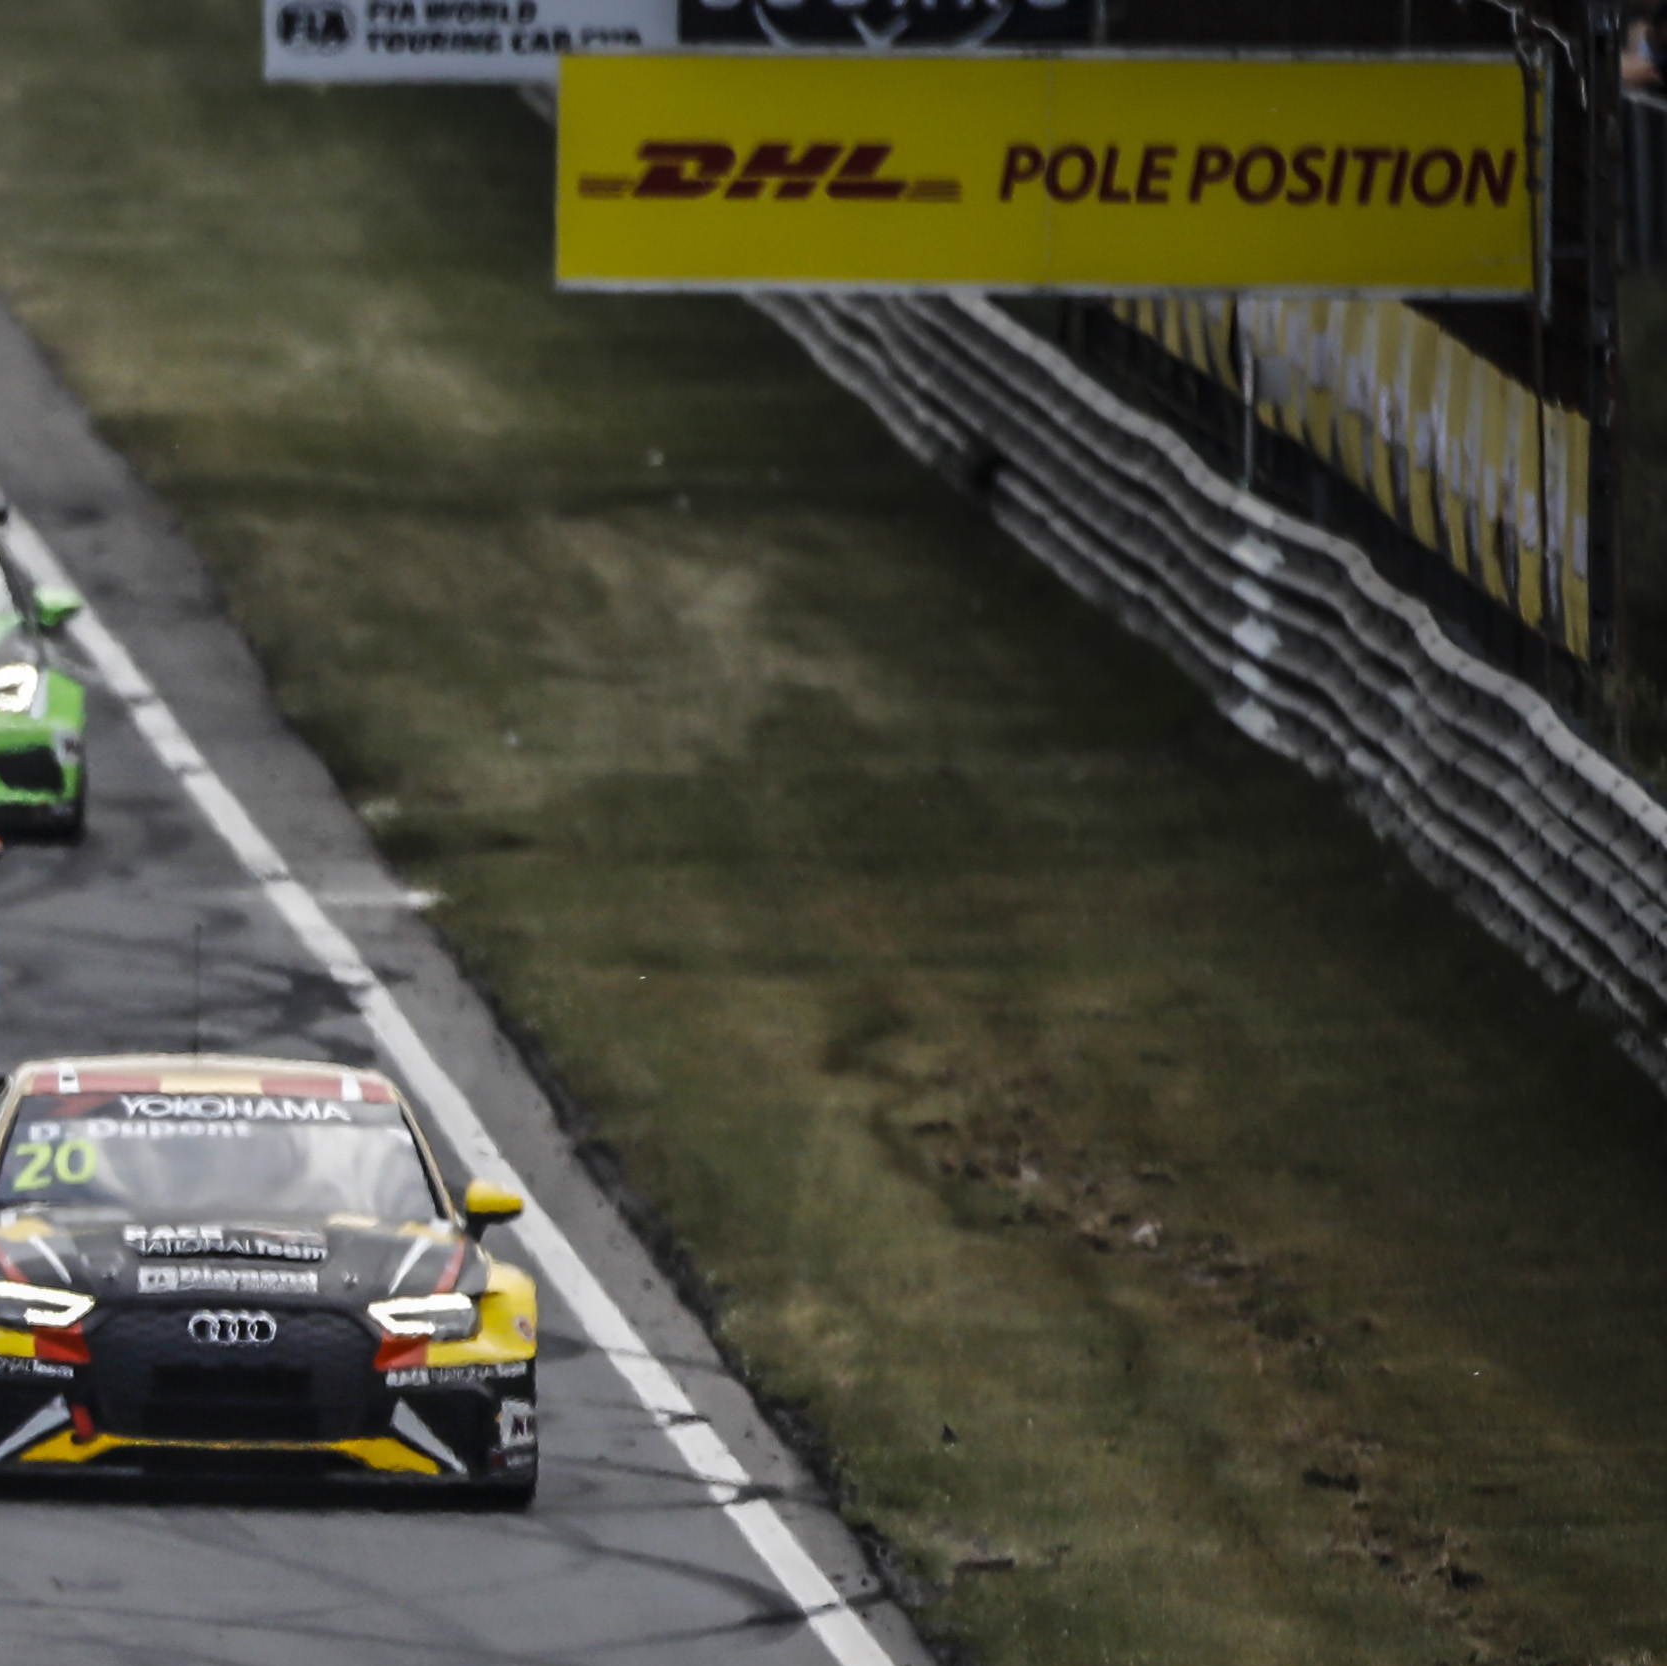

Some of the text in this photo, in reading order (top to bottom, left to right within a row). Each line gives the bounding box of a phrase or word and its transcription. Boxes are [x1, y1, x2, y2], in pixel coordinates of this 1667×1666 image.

[636, 143, 911, 199] DHL
[1001, 146, 1515, 207] POLE POSITION
[120, 1096, 351, 1121] YOKOHAMA
[13, 1140, 97, 1192] 20
